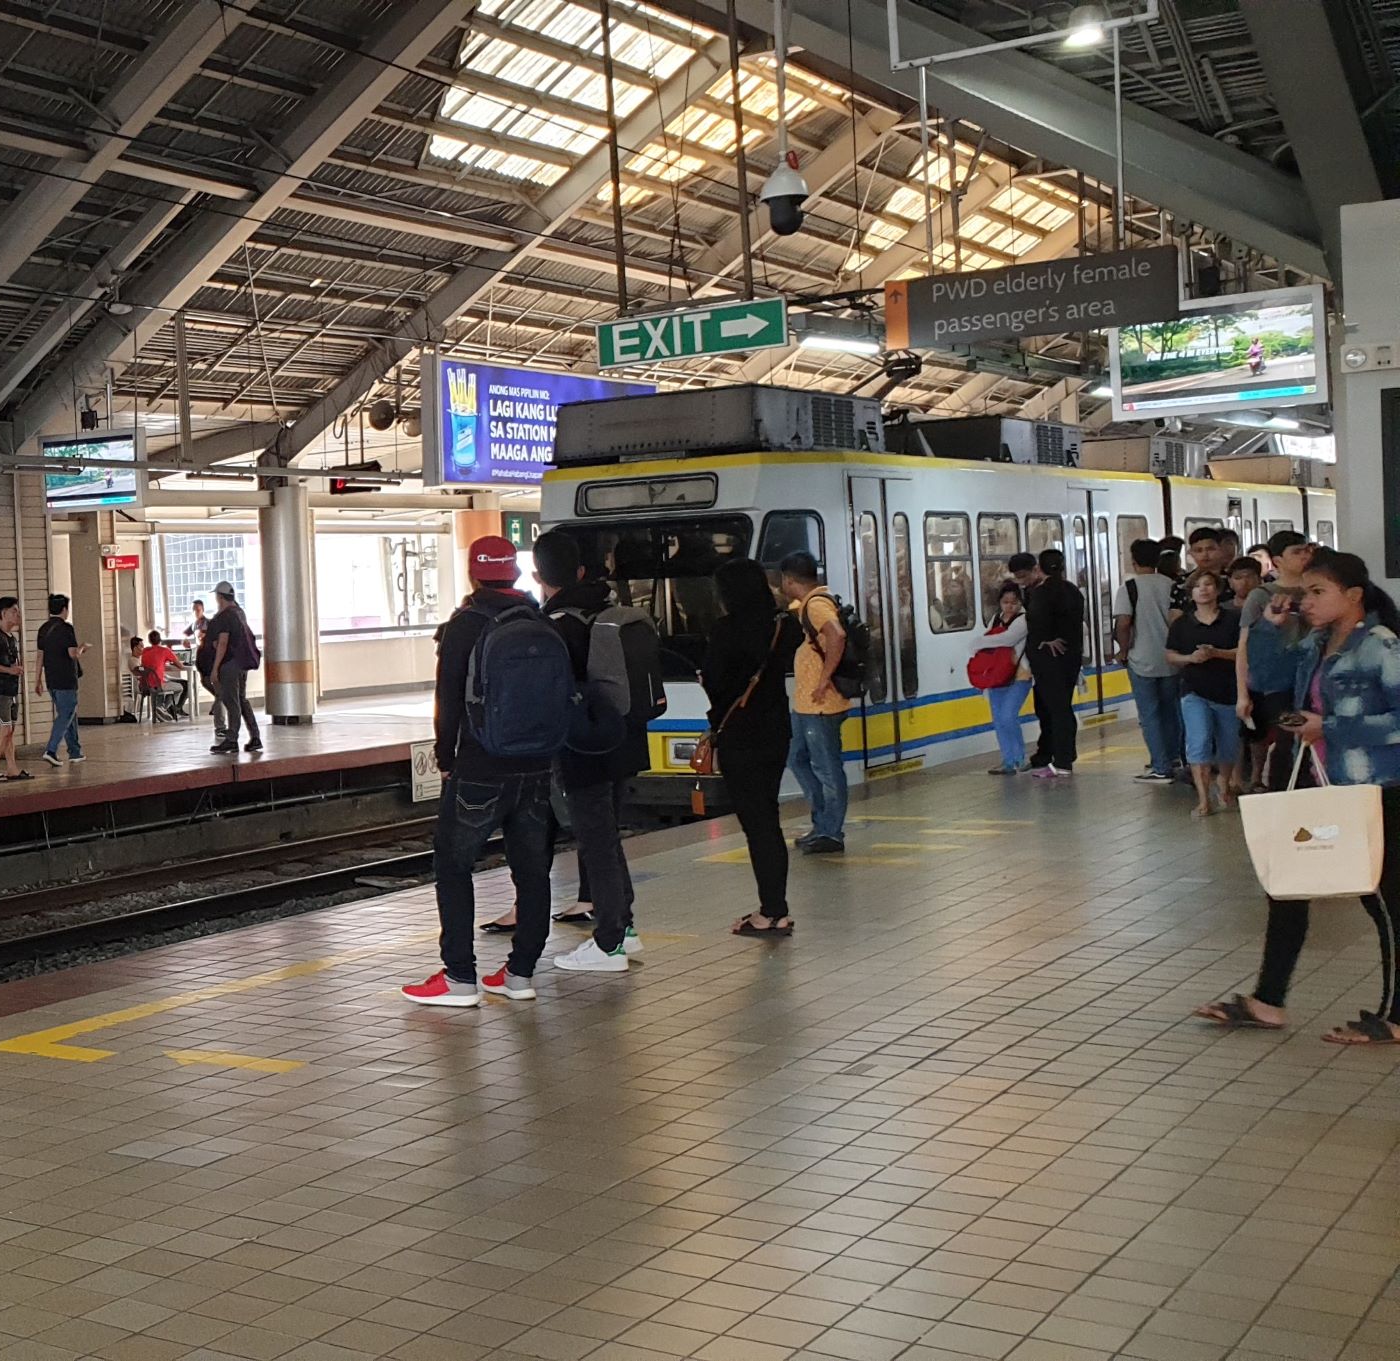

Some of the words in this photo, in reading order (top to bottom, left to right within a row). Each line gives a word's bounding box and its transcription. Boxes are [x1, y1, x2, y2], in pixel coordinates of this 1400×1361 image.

[932, 278, 988, 303] PWD
[993, 269, 1067, 293] elderly
[1072, 257, 1152, 285] female
[933, 300, 1060, 341] passenger's
[1066, 300, 1116, 320] area
[611, 311, 712, 363] EXIT
[489, 384, 508, 396] ANONG
[509, 386, 520, 397] MAS
[489, 399, 514, 418] LAGI
[516, 402, 544, 420] KANG
[490, 421, 504, 438] SA
[506, 422, 548, 441] STATION
[490, 443, 528, 461] MAAGA
[530, 445, 553, 463] ANG
